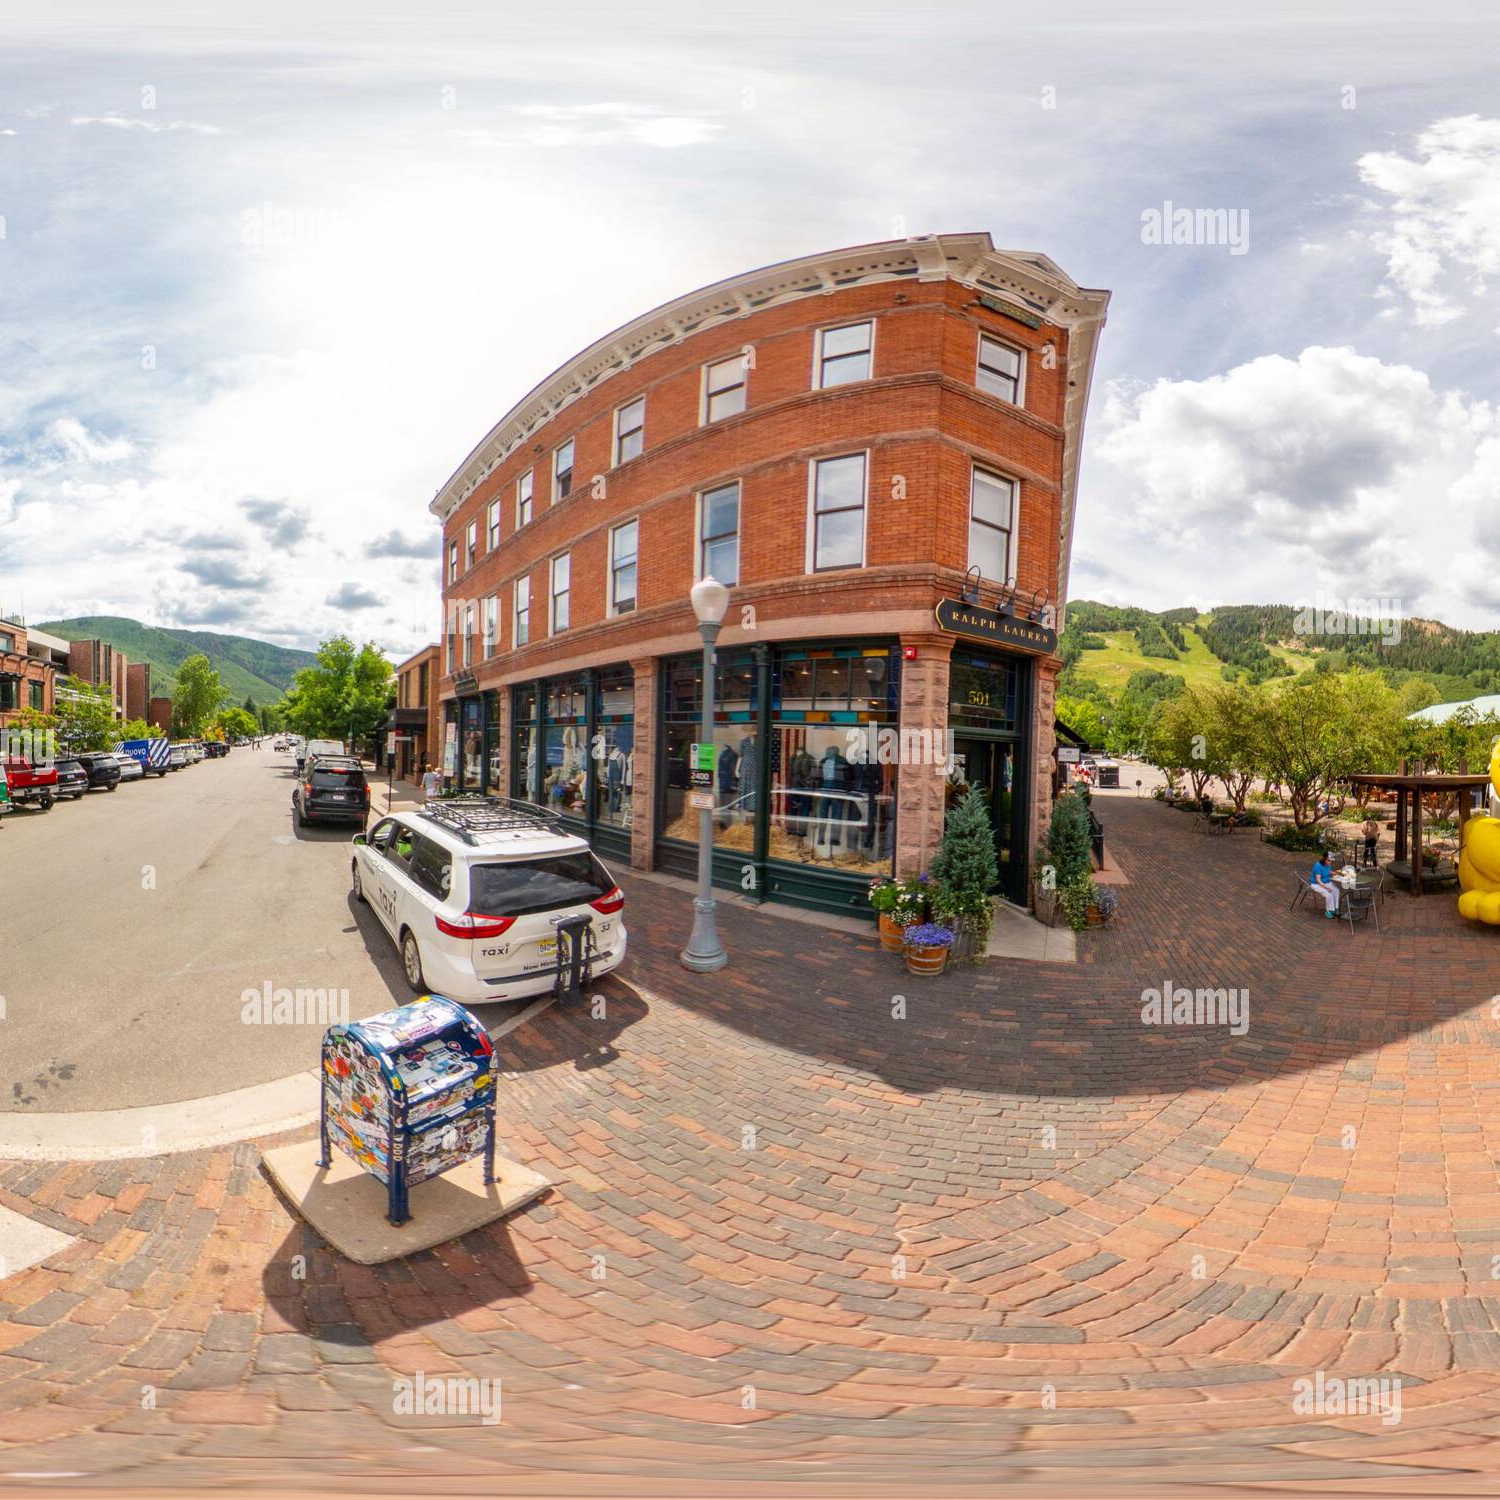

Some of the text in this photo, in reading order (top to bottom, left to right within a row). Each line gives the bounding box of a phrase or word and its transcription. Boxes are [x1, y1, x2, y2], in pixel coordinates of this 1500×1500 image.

[952, 611, 1049, 644] RALPH LAUREN
[968, 690, 989, 706] 501
